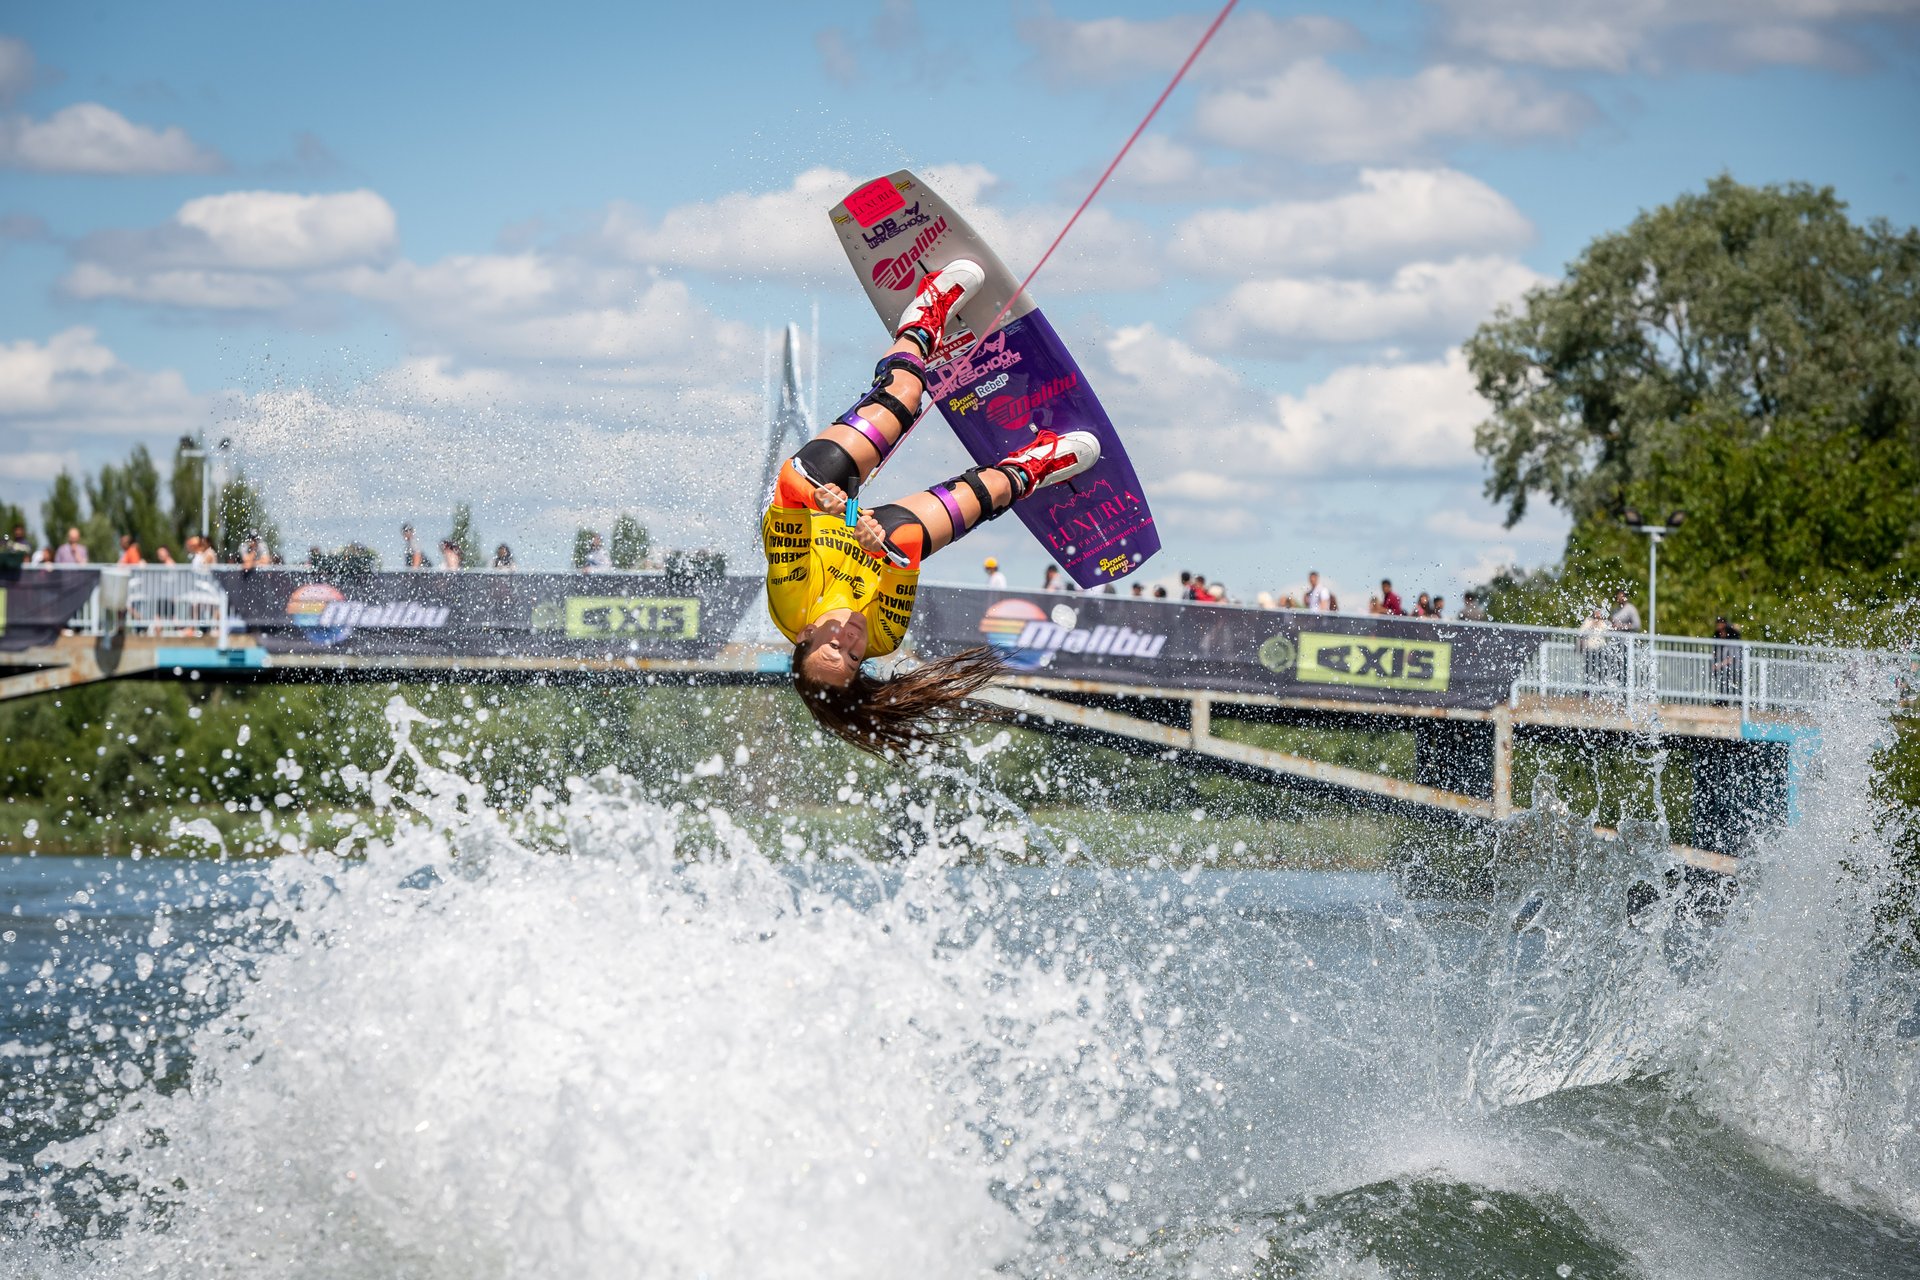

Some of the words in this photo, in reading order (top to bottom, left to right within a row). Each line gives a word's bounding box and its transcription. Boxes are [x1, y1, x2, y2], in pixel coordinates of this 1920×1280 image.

[862, 217, 898, 244] LDB
[868, 212, 931, 249] WAKESCHOOL
[977, 376, 1005, 396] Rebel
[949, 392, 976, 412] Brace
[774, 521, 803, 535] 2019
[1047, 490, 1141, 550] LUXURIA
[1099, 553, 1127, 571] Brace
[1108, 559, 1133, 577] pimp
[1316, 643, 1435, 680] AXIS
